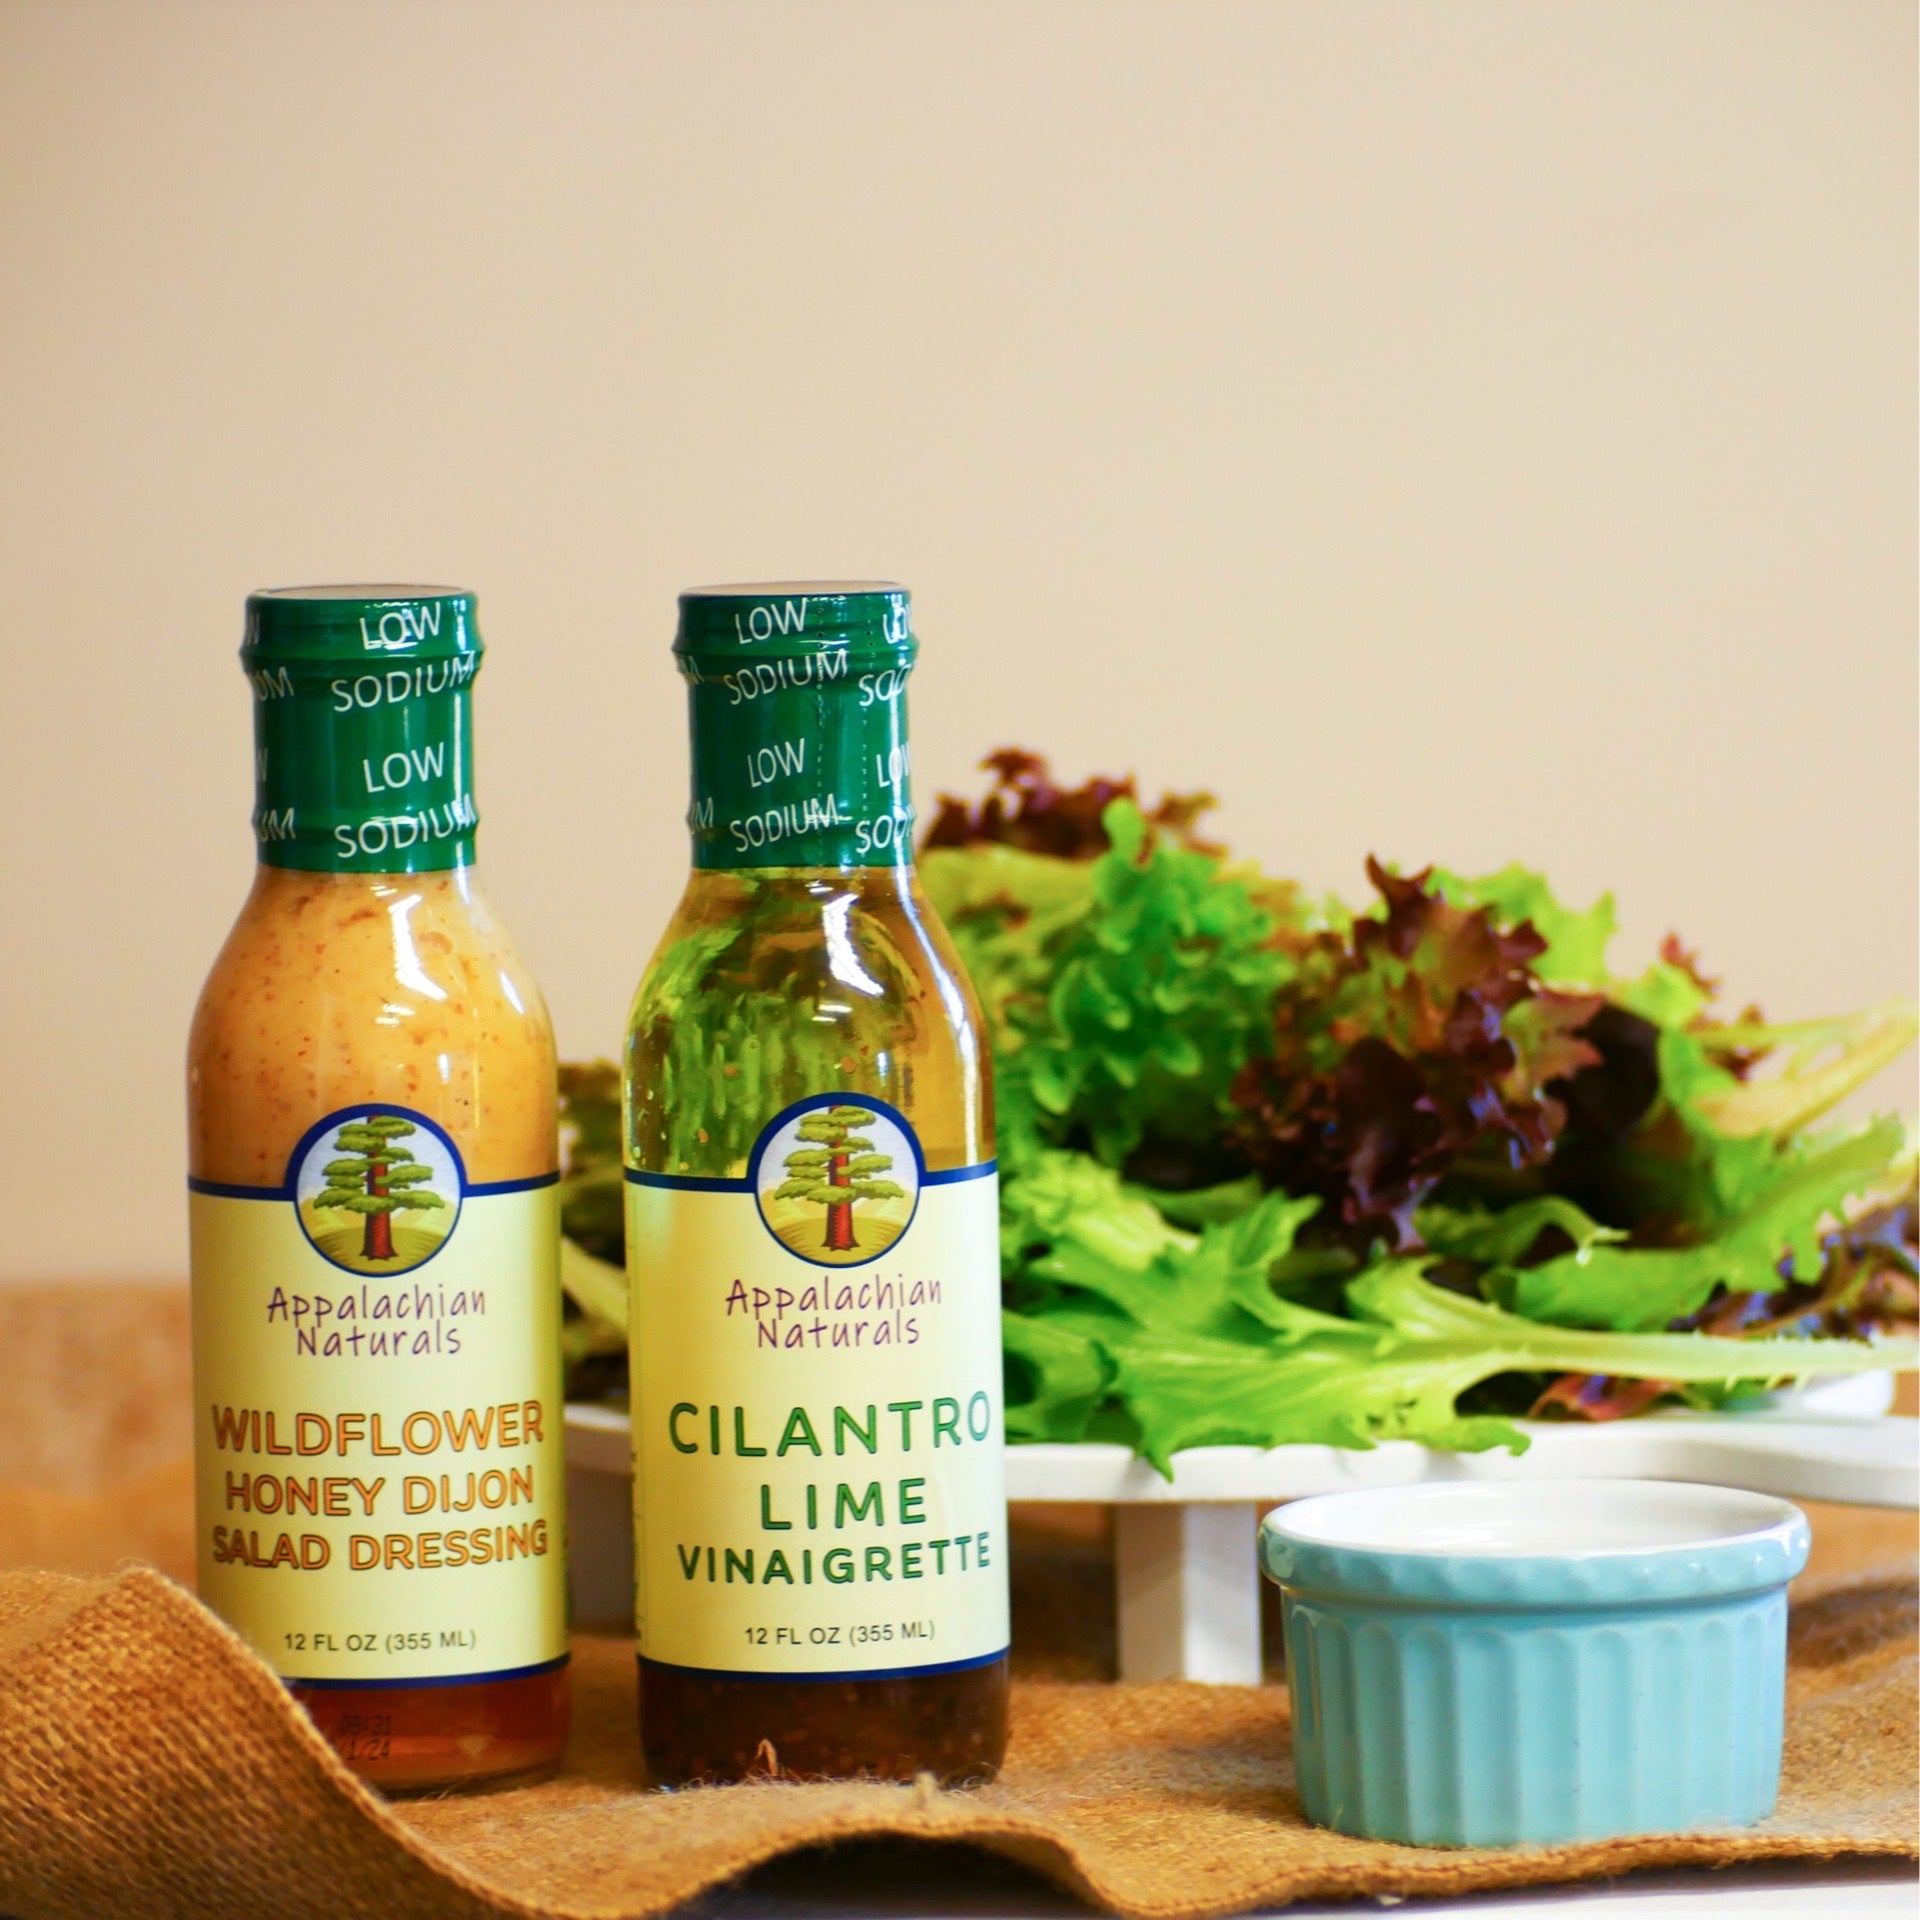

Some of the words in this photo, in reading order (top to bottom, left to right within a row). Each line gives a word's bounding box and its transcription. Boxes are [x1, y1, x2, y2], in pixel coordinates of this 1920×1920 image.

[360, 601, 441, 650] LOW
[735, 597, 807, 644] LOW
[331, 651, 475, 712] SODIUM
[723, 648, 848, 705] SODIUM
[363, 742, 444, 793] LOW
[747, 738, 805, 788] LOW
[334, 794, 476, 858] SODIUM
[729, 793, 839, 852] SODIUM
[267, 1284, 486, 1329] Appalachian
[726, 1274, 942, 1320] Appalachian
[297, 1320, 461, 1357] Naturals
[757, 1310, 919, 1349] Naturals
[212, 1400, 544, 1456] WILDFLOWER
[669, 1391, 990, 1457] CILANTRO
[225, 1471, 385, 1515] HONEY
[404, 1465, 533, 1515] DIJON
[760, 1477, 926, 1530] LIME
[213, 1525, 330, 1570] SALAD
[349, 1519, 547, 1570] DRESSING
[677, 1532, 990, 1585] VINAIGRETTE
[285, 1633, 306, 1650] 12
[314, 1634, 338, 1651] FL
[346, 1634, 377, 1651] OZ
[386, 1633, 431, 1654] (355
[440, 1630, 476, 1649] ML)
[745, 1627, 767, 1644] 12
[776, 1627, 801, 1645] FL
[810, 1627, 840, 1644] OZ
[849, 1624, 893, 1647] (355
[901, 1620, 935, 1641] ML)
